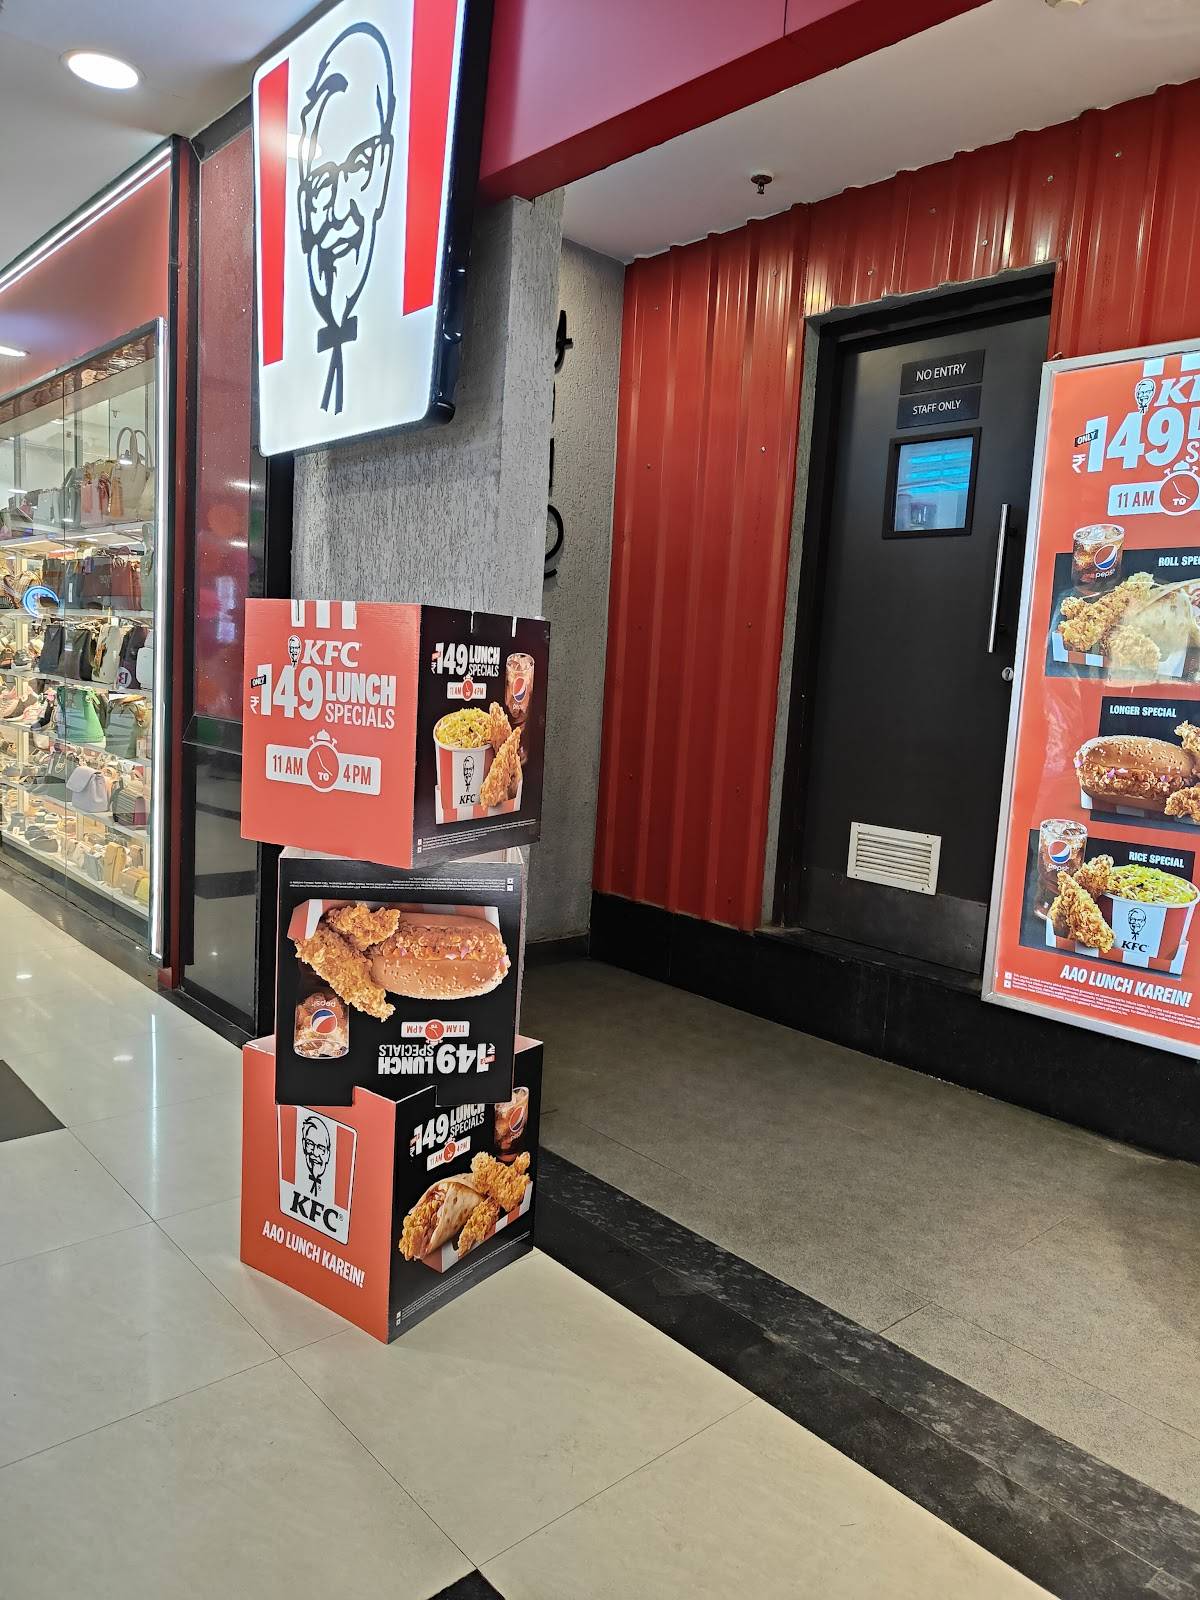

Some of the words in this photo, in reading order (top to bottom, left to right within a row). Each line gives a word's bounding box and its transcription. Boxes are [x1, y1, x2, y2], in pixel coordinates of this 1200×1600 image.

[916, 369, 932, 381] NO
[934, 363, 967, 379] ENTRY
[912, 403, 937, 415] STAFF
[938, 400, 961, 411] ONLY
[1077, 431, 1097, 445] ONLY
[1117, 493, 1128, 508] 11
[1132, 491, 1154, 507] AM
[1173, 498, 1186, 506] TO
[1158, 556, 1179, 567] ROLL
[301, 639, 361, 668] KFC
[469, 645, 500, 665] LUNCH
[468, 663, 500, 677] SPECIALS
[252, 676, 265, 687] ONLY
[325, 670, 397, 707] LUNCH
[325, 702, 396, 730] SPECIALS
[1109, 705, 1140, 716] LONGER
[1142, 707, 1177, 717] SPECIAL
[273, 754, 282, 774] 11
[285, 756, 303, 776] AM
[317, 771, 330, 782] TO
[343, 763, 351, 783] 4
[353, 765, 372, 786] PM
[459, 794, 476, 805] KFC
[1128, 851, 1148, 863] RICE
[1149, 854, 1185, 868] SPECIAL
[1121, 940, 1148, 953] KFC
[1060, 965, 1088, 983] AAO
[1089, 971, 1134, 994] LUNCH
[1134, 981, 1193, 1008] KAREIN!
[446, 1024, 458, 1033] AM
[378, 1044, 435, 1056] SPECIALS
[378, 1056, 434, 1075] LUNCH
[450, 1113, 485, 1137] SPECIALS
[290, 1190, 339, 1233] KFC
[262, 1220, 285, 1244] AAO
[285, 1231, 322, 1263] LUNCH
[321, 1249, 365, 1289] KAREIN!
